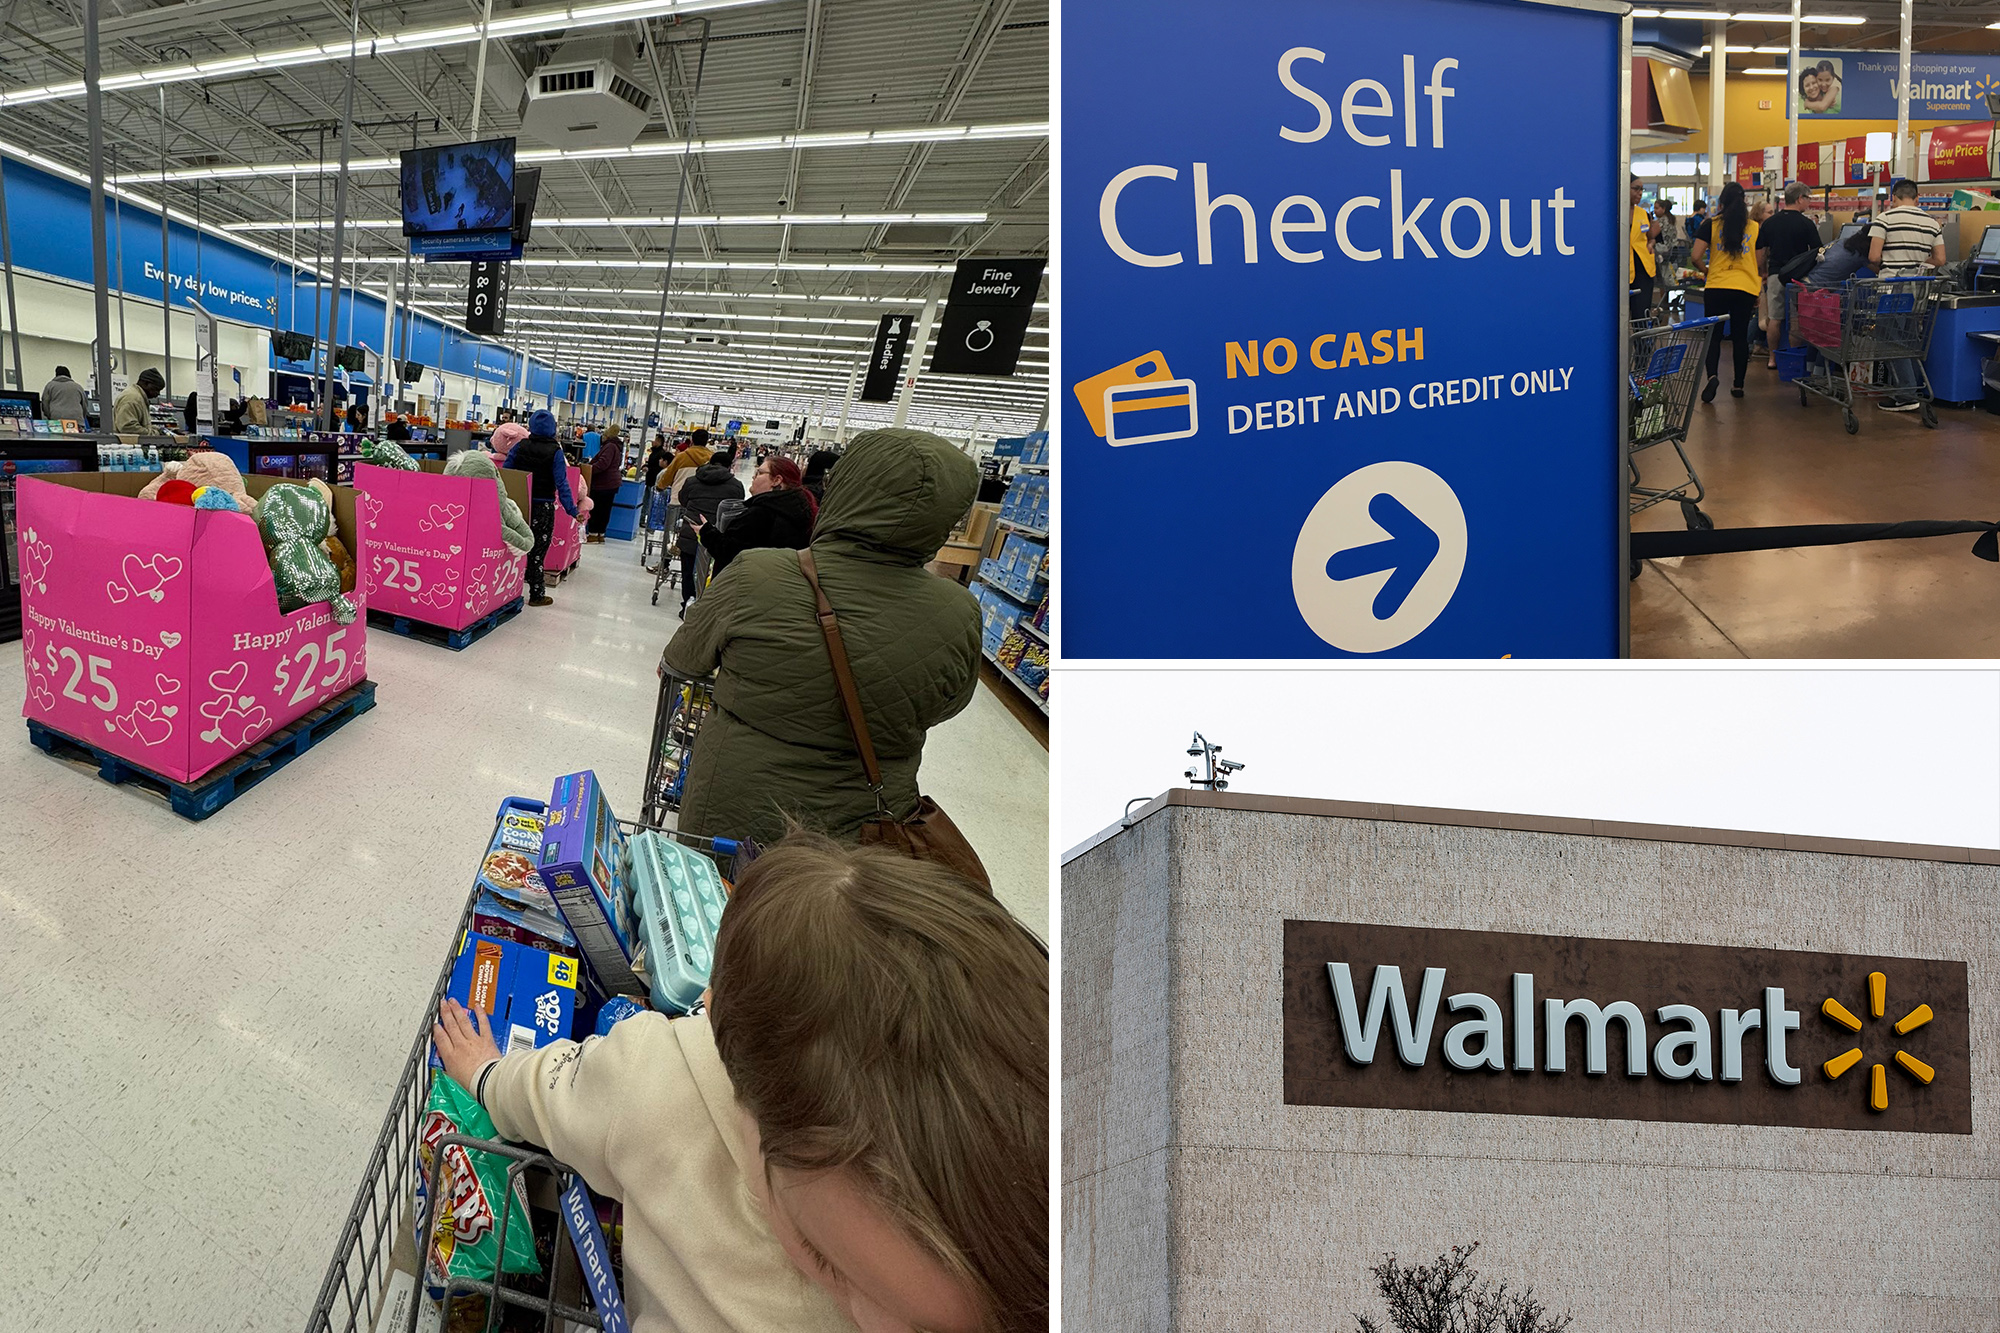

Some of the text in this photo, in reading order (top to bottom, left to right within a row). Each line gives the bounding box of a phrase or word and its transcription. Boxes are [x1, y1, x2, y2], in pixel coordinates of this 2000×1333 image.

[1857, 62, 1976, 75] Thank you shopping at your
[1277, 47, 1459, 149] Self
[1926, 102, 1971, 111] Supercentre
[1934, 144, 1983, 159] Low Prices
[1799, 160, 1817, 171] Prices
[1099, 162, 1576, 268] Checkout
[421, 236, 442, 245] Security
[443, 236, 465, 244] cameras
[477, 276, 489, 289] &
[982, 269, 1012, 281] Fine
[184, 275, 206, 296] day
[208, 280, 228, 299] low
[230, 290, 263, 309] prices.
[967, 283, 1020, 298] Jewelry
[474, 293, 488, 316] Go
[496, 297, 504, 319] Go
[879, 337, 898, 370] Ladies
[1225, 327, 1425, 380] NO CASH
[1227, 366, 1575, 435] DEBIT AND CREDIT ONLY
[747, 428, 763, 436] arden
[764, 429, 782, 437] Center
[270, 456, 288, 467] pepsi
[306, 454, 322, 463] pepsi
[365, 538, 452, 561] appy Valentine's Day
[372, 554, 422, 593] $25
[492, 556, 520, 596] $25
[28, 604, 164, 660] Happy Valentine's Day
[233, 627, 293, 651] Happy
[45, 640, 119, 712] $25
[273, 628, 347, 707] $25
[502, 834, 541, 851] Doug
[503, 827, 542, 841] Cook
[482, 960, 492, 985] BROWN
[554, 960, 569, 982] 48
[475, 965, 485, 1002] CINNAMON
[1326, 961, 1801, 1086] Walmart
[568, 1186, 608, 1293] Walmart
